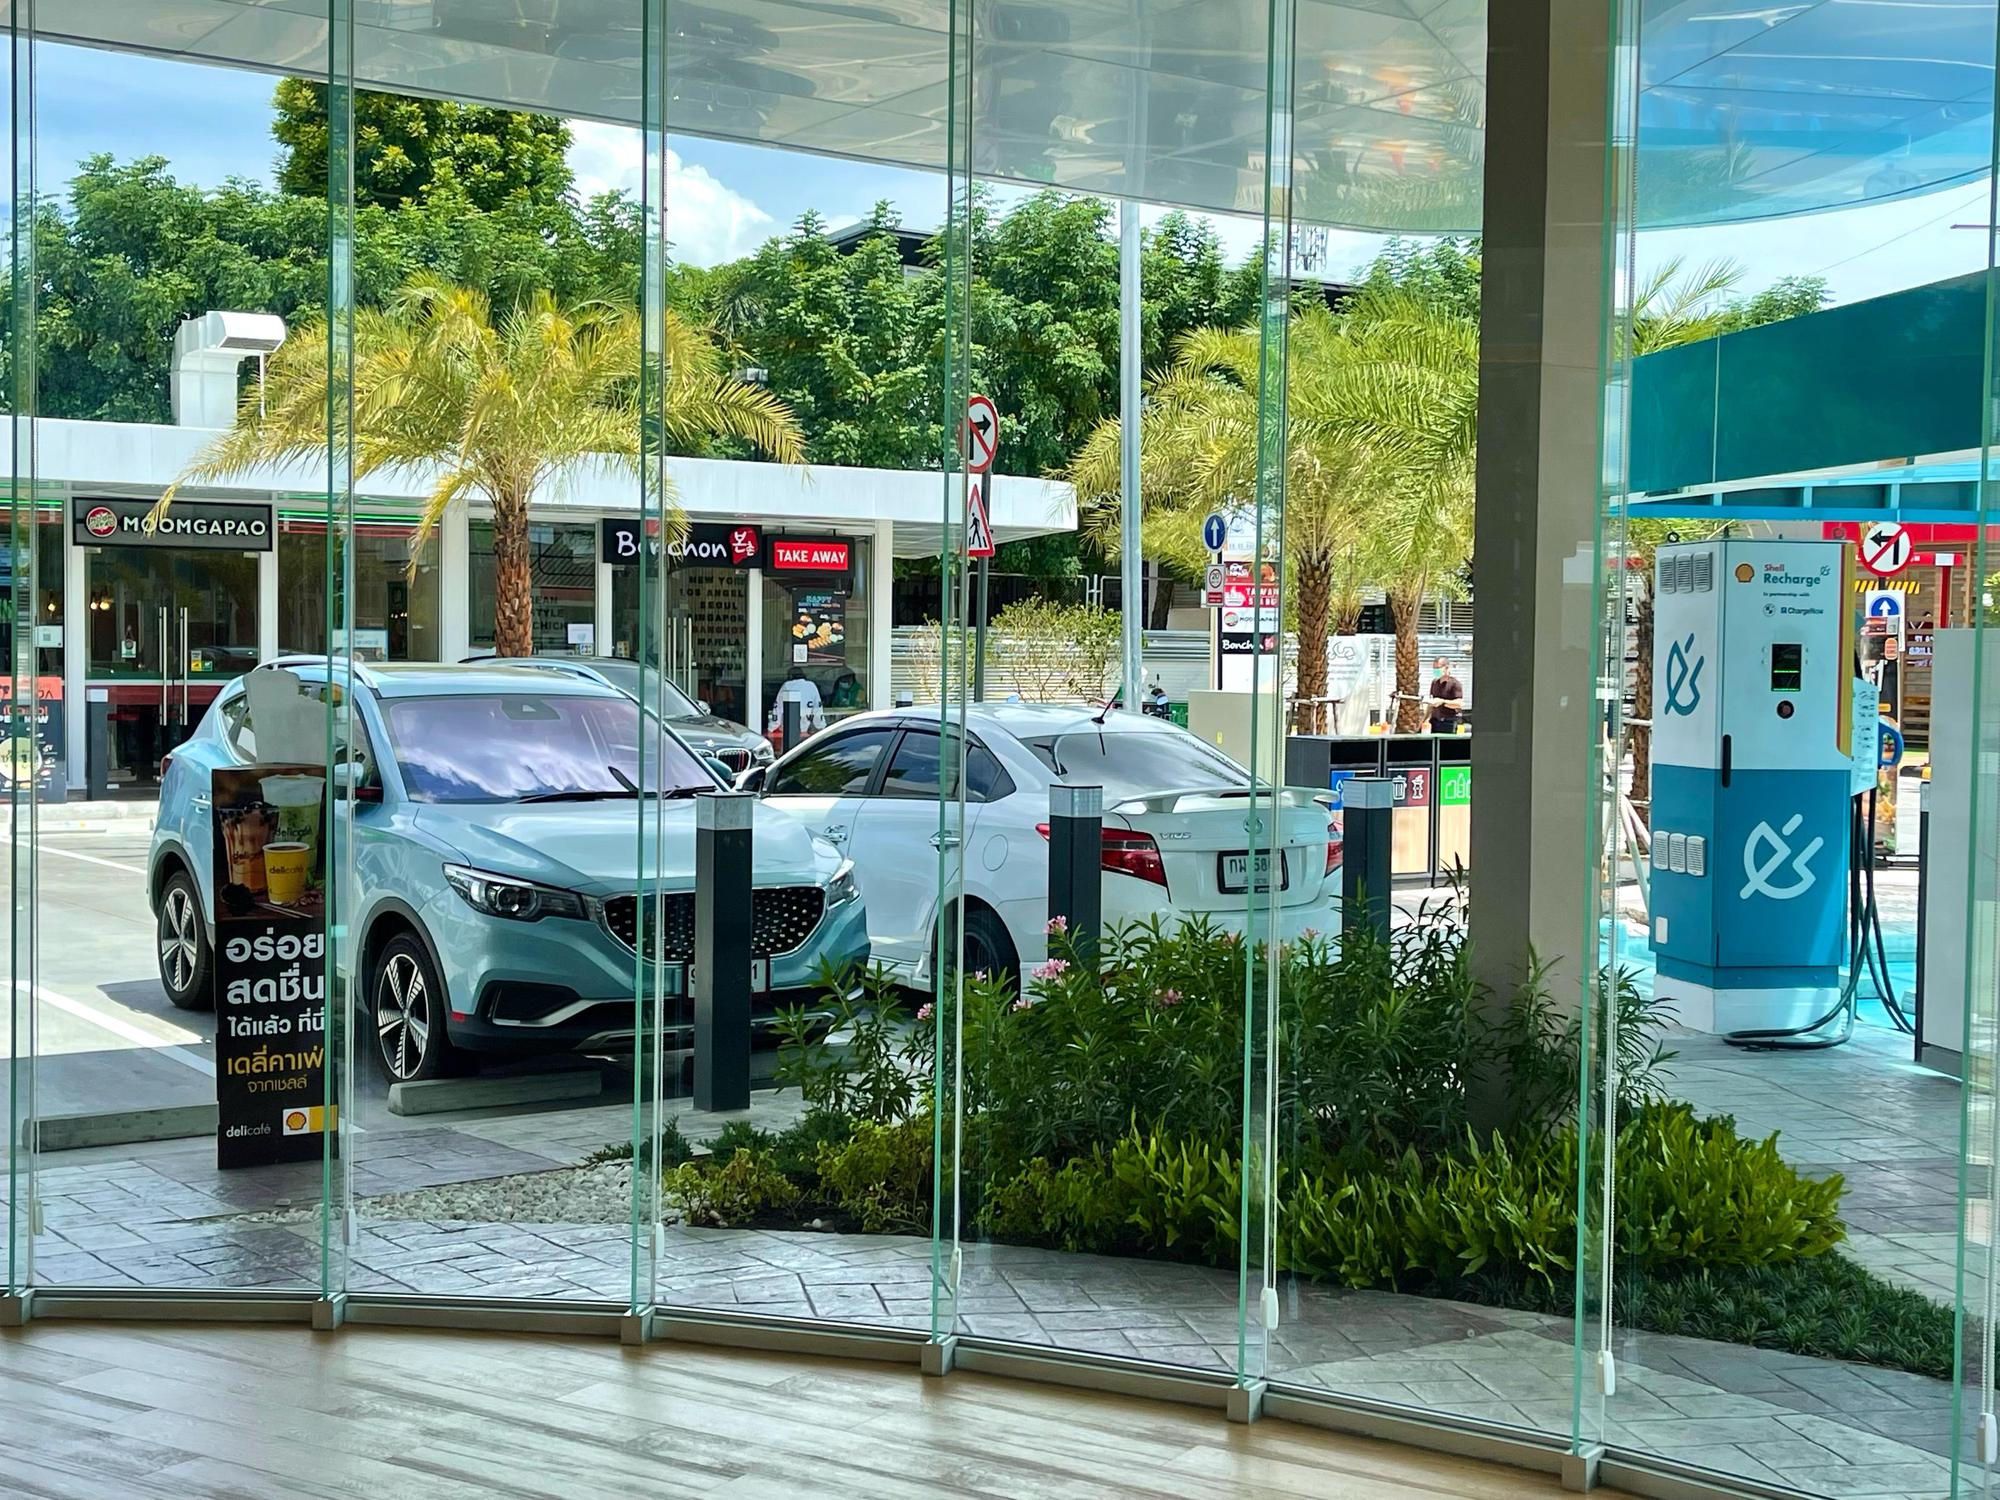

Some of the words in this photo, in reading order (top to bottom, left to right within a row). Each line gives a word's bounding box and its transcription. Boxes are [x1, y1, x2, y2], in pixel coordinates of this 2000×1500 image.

[123, 516, 266, 536] MOOMGAPAO
[615, 531, 727, 558] Bnchon
[777, 549, 809, 563] TAKE
[811, 551, 846, 564] AWAY
[1764, 564, 1785, 572] Shell
[1763, 572, 1821, 587] Recharge
[1222, 640, 1264, 650] Bonchn
[226, 927, 325, 963] อร่อย
[227, 962, 325, 1005] สดชื่น
[227, 1014, 291, 1037] ได้แล้ว
[298, 1006, 325, 1032] ที่นี่
[226, 1123, 271, 1138] delicafé
